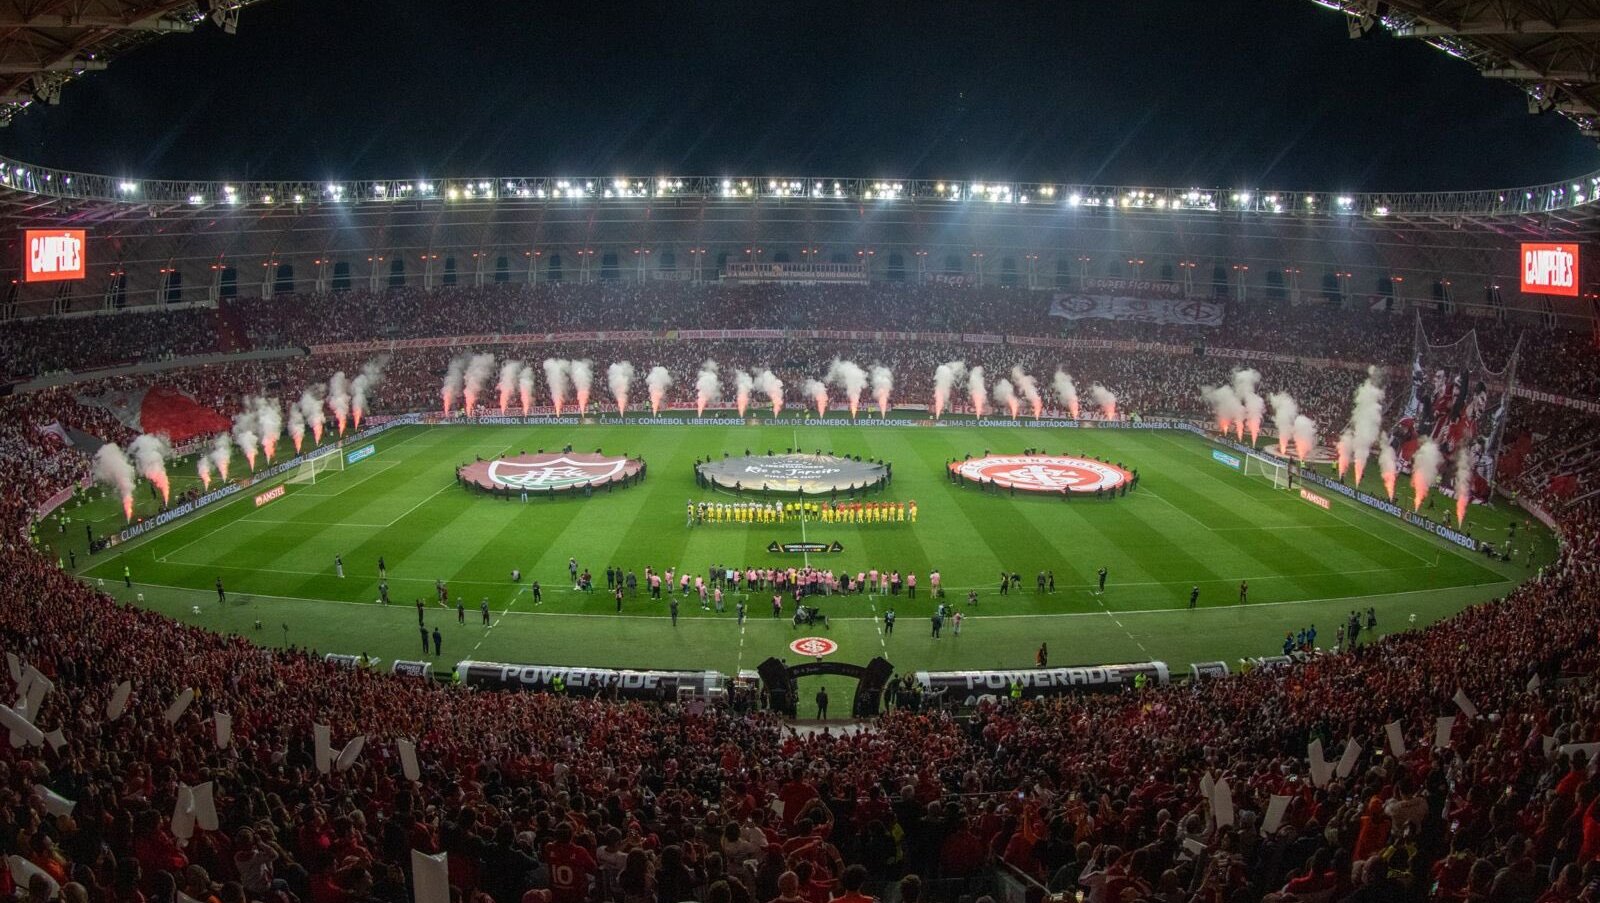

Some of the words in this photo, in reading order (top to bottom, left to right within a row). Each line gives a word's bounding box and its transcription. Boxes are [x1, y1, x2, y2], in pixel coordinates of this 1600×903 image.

[1511, 386, 1556, 404] GUARDA
[444, 417, 466, 425] CLIMA
[467, 417, 477, 425] DE
[479, 417, 521, 425] CONMEBOL
[523, 417, 579, 425] LIBERTADORES
[638, 418, 684, 426] CONMEBOL
[687, 418, 745, 426] LIBERTADORES
[853, 419, 912, 427] LIBERTADORES
[979, 420, 1022, 428] CONMEBOL
[1024, 420, 1079, 429] LIBERTADORES
[1121, 421, 1131, 429] DE
[1133, 422, 1172, 430] CONMEBOL
[263, 486, 285, 503] AMSTEL
[1301, 469, 1316, 483] CLIMA
[1316, 475, 1324, 485] DE
[1324, 478, 1356, 499] CONMEBOL
[1357, 491, 1402, 518] LIBERTADORES
[1306, 492, 1330, 509] AMSTEL
[121, 526, 144, 541] CLIMA
[144, 519, 155, 531] DE
[156, 503, 194, 525] CONMEBOL
[195, 484, 239, 509] LIBERTADORES
[1405, 512, 1424, 527] CLIMA
[1425, 520, 1435, 532] DE
[1436, 524, 1476, 551] CONMEBOL
[966, 668, 1123, 690] POWERADE
[552, 864, 573, 885] 10
